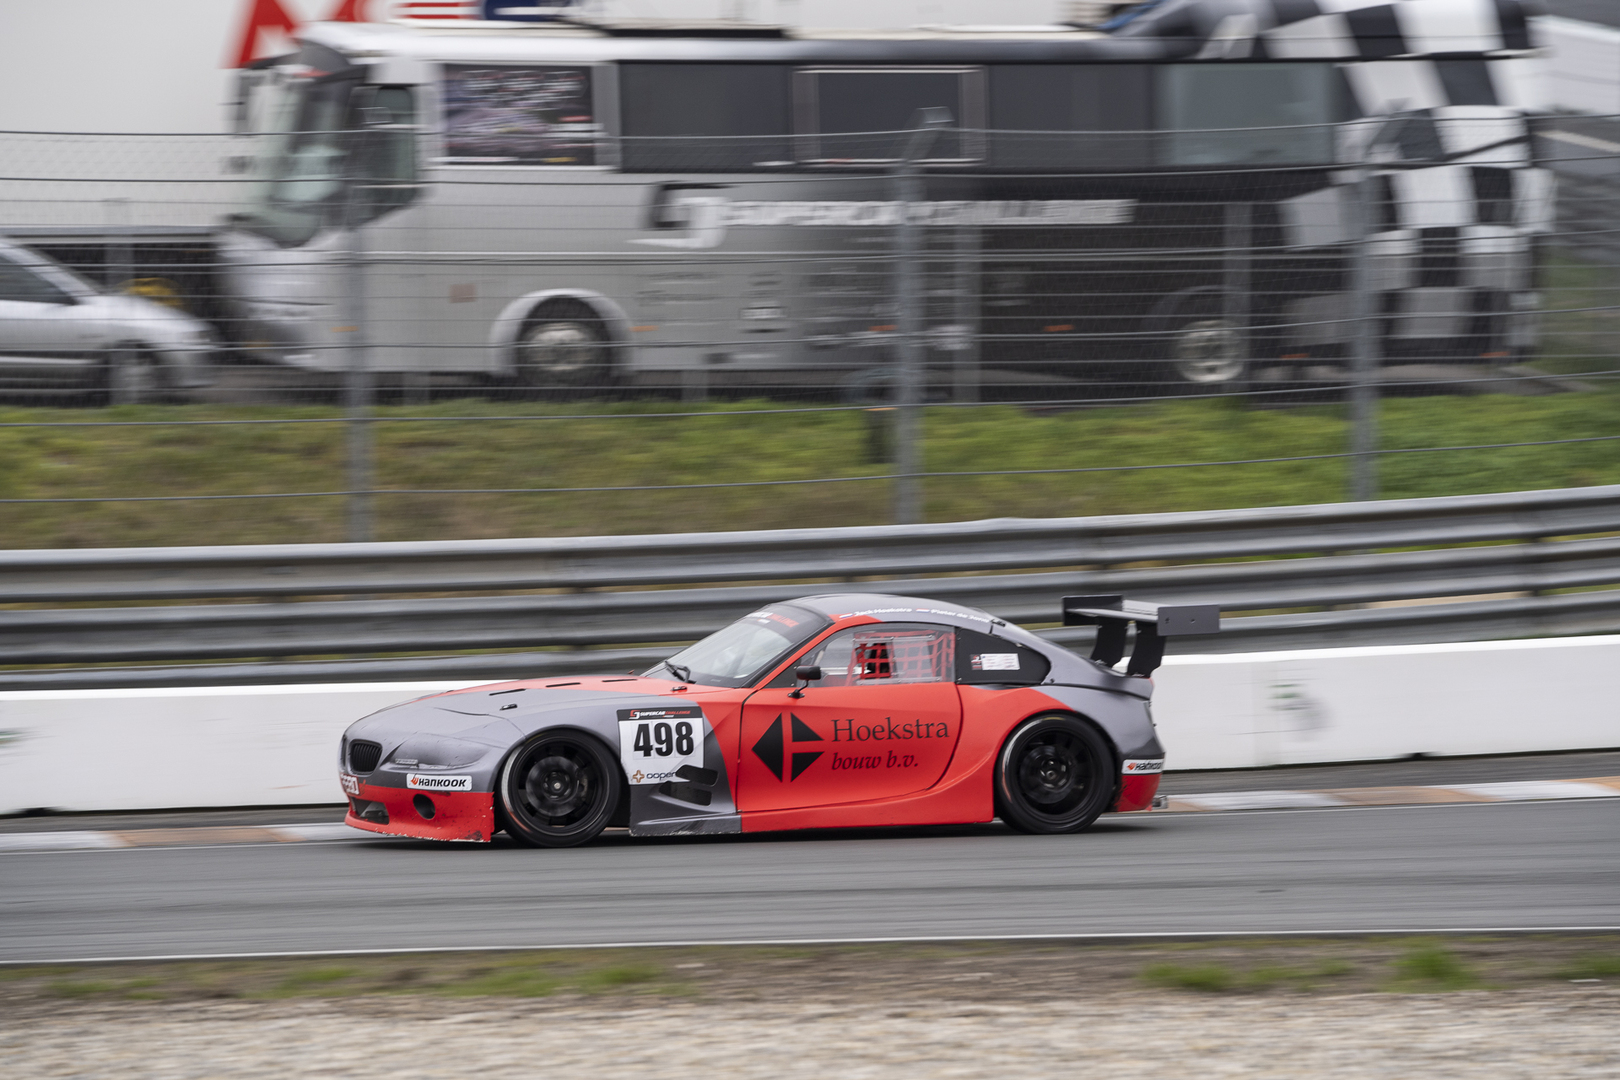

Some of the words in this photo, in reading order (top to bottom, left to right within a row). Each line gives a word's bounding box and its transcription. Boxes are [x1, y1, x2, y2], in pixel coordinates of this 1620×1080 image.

[633, 722, 694, 757] 498
[831, 716, 950, 742] Hoekstra
[831, 752, 882, 770] bouw
[886, 750, 919, 768] b.v.
